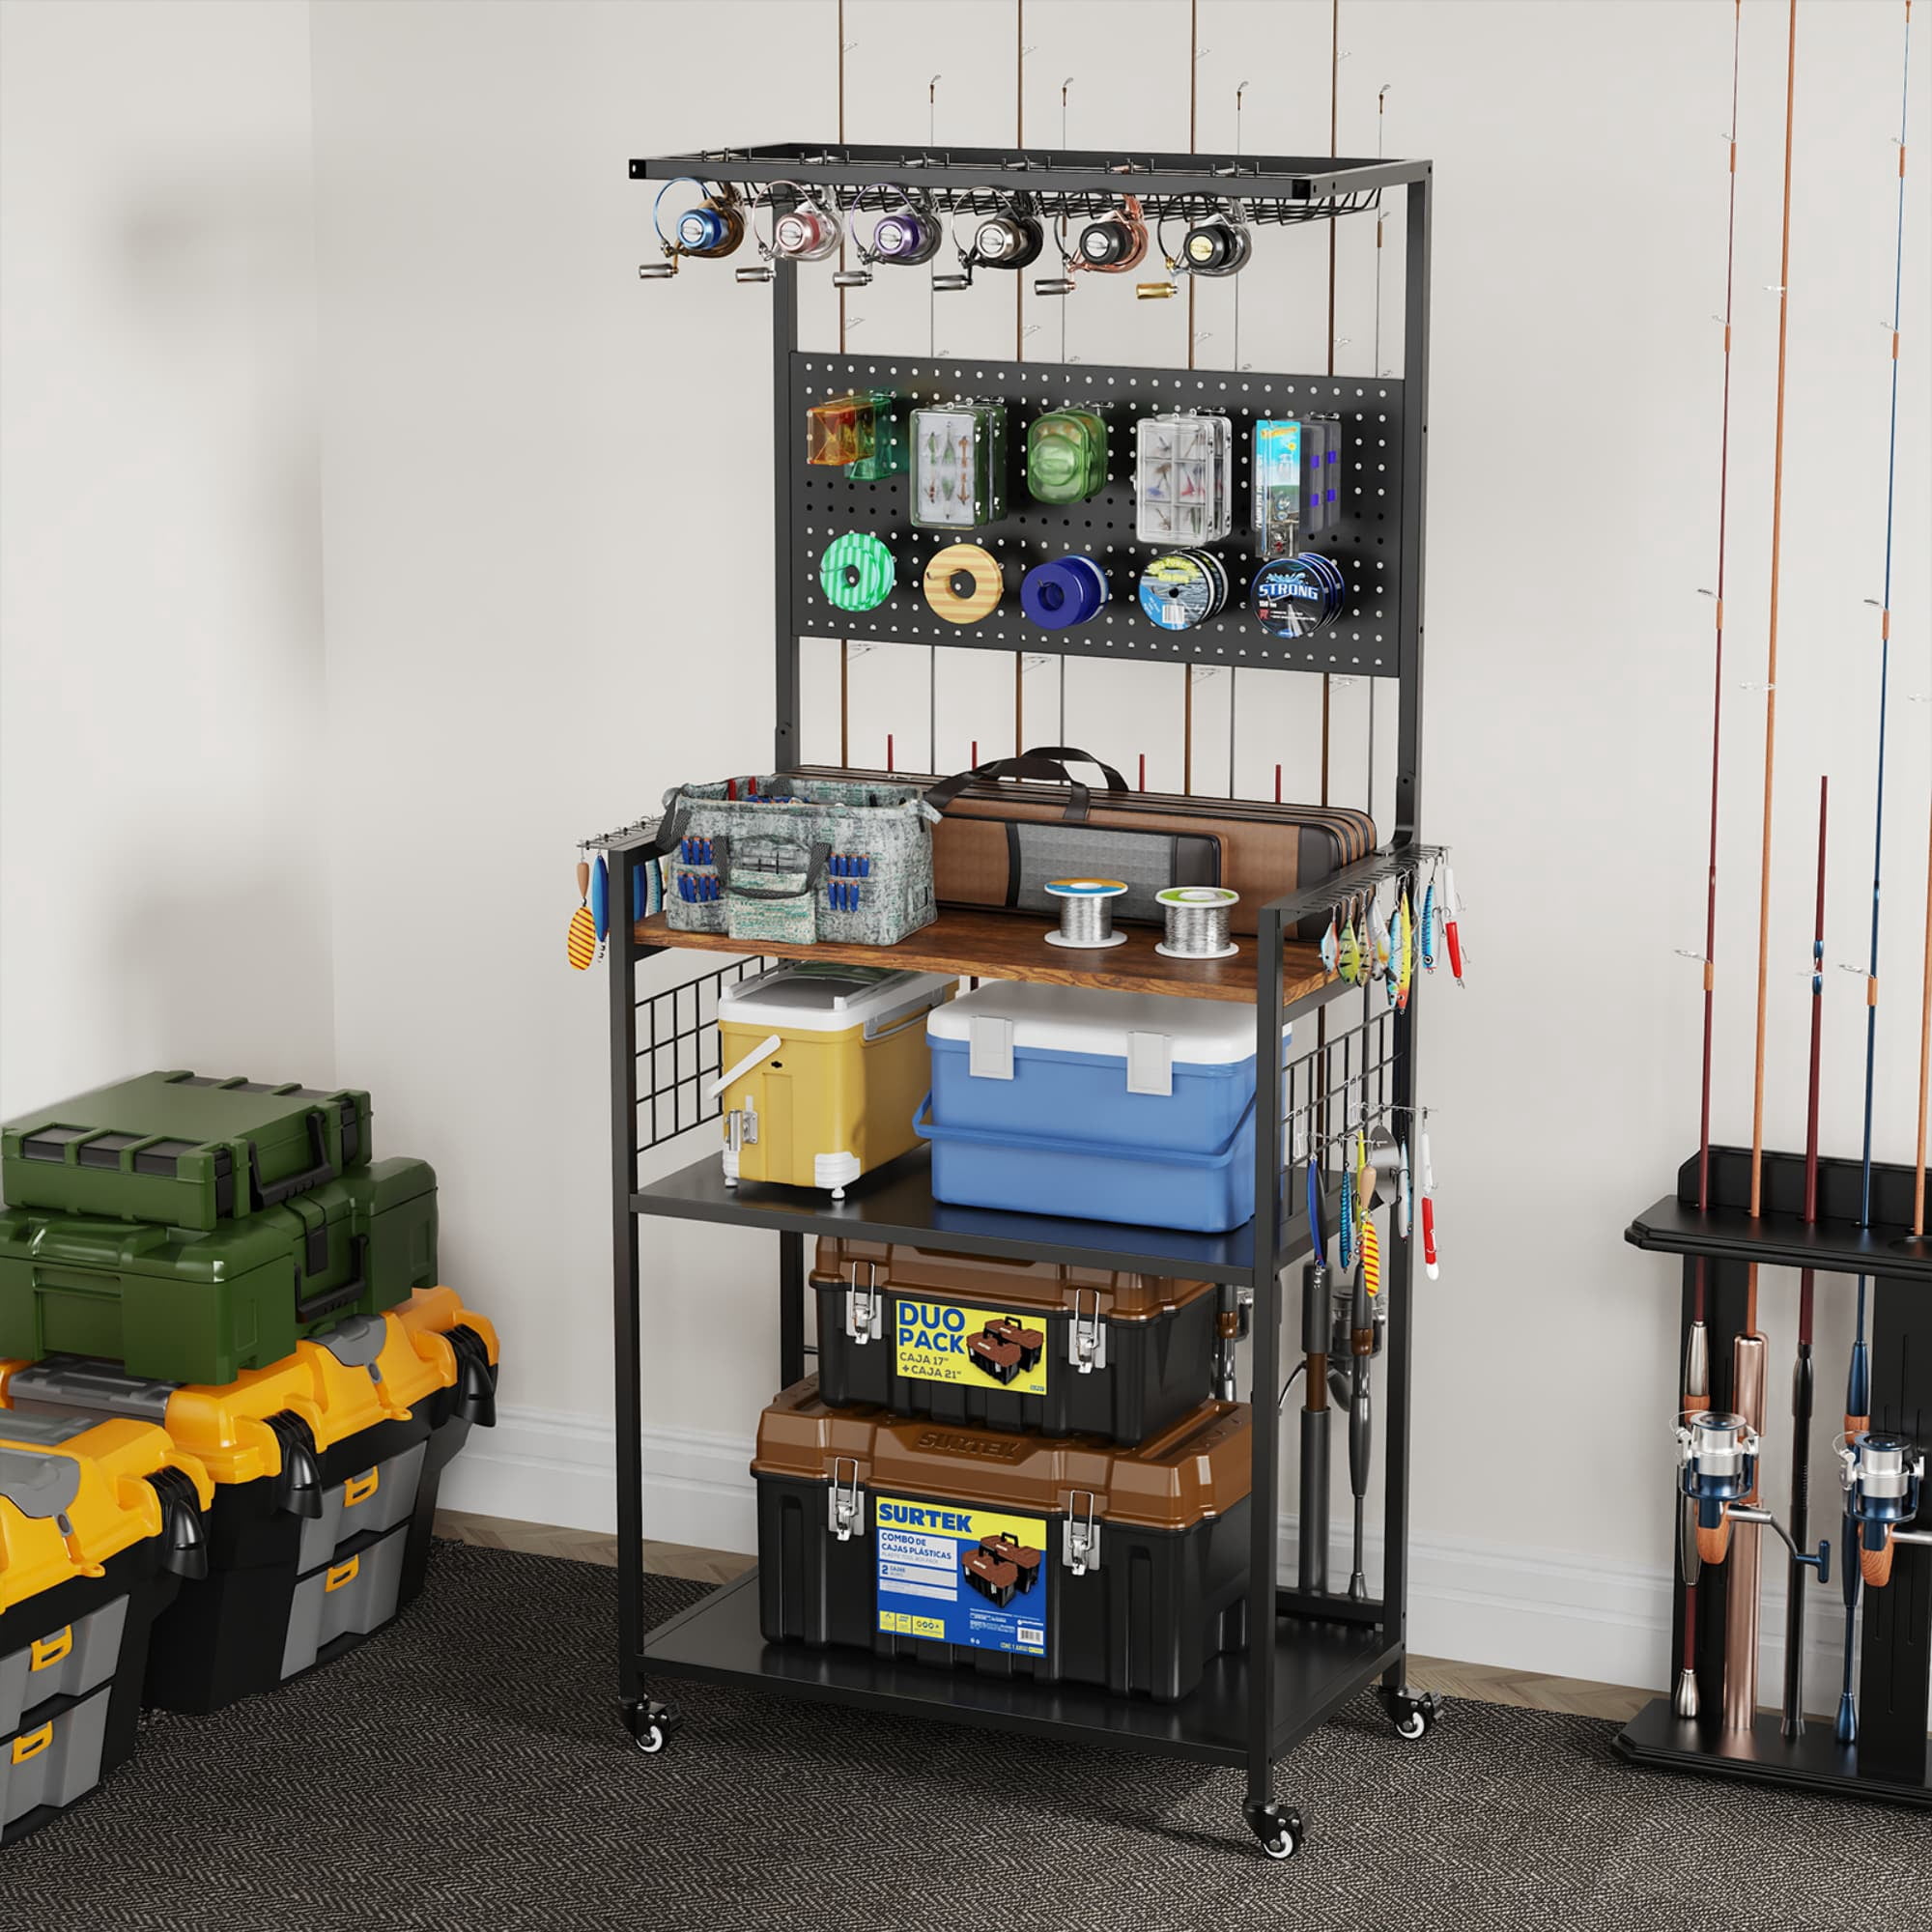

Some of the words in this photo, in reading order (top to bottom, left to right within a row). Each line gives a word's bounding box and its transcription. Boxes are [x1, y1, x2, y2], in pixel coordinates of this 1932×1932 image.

[1259, 583, 1319, 600] STRONG
[898, 1302, 965, 1332] DUO
[898, 1327, 965, 1354] PACK
[899, 1351, 930, 1364] CAJA
[919, 1432, 1020, 1459] SURTEK
[878, 1503, 973, 1533] SURTEK
[881, 1532, 915, 1545] COMBO
[881, 1543, 908, 1554] CAJAS
[909, 1546, 952, 1560] PLÁSTICAS
[881, 1565, 889, 1575] 2
